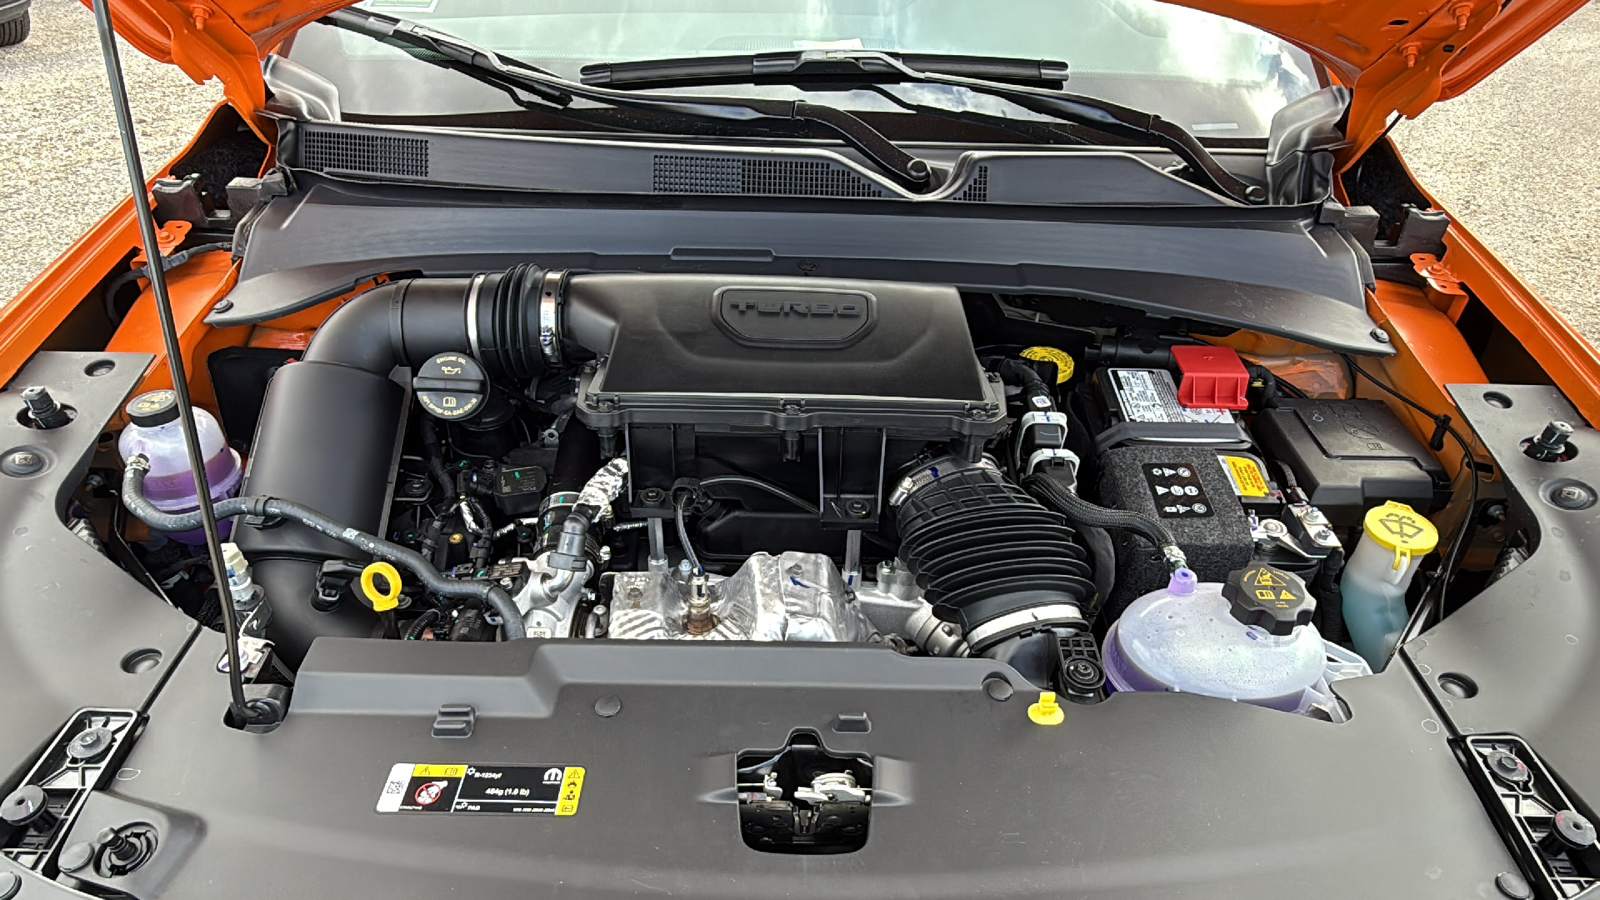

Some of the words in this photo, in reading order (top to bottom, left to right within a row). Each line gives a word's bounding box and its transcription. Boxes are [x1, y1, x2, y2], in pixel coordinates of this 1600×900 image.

[730, 301, 861, 317] TURBO
[436, 356, 457, 364] ENGINE
[458, 357, 466, 365] OIL
[485, 788, 504, 796] 454g
[520, 788, 530, 796] lb)
